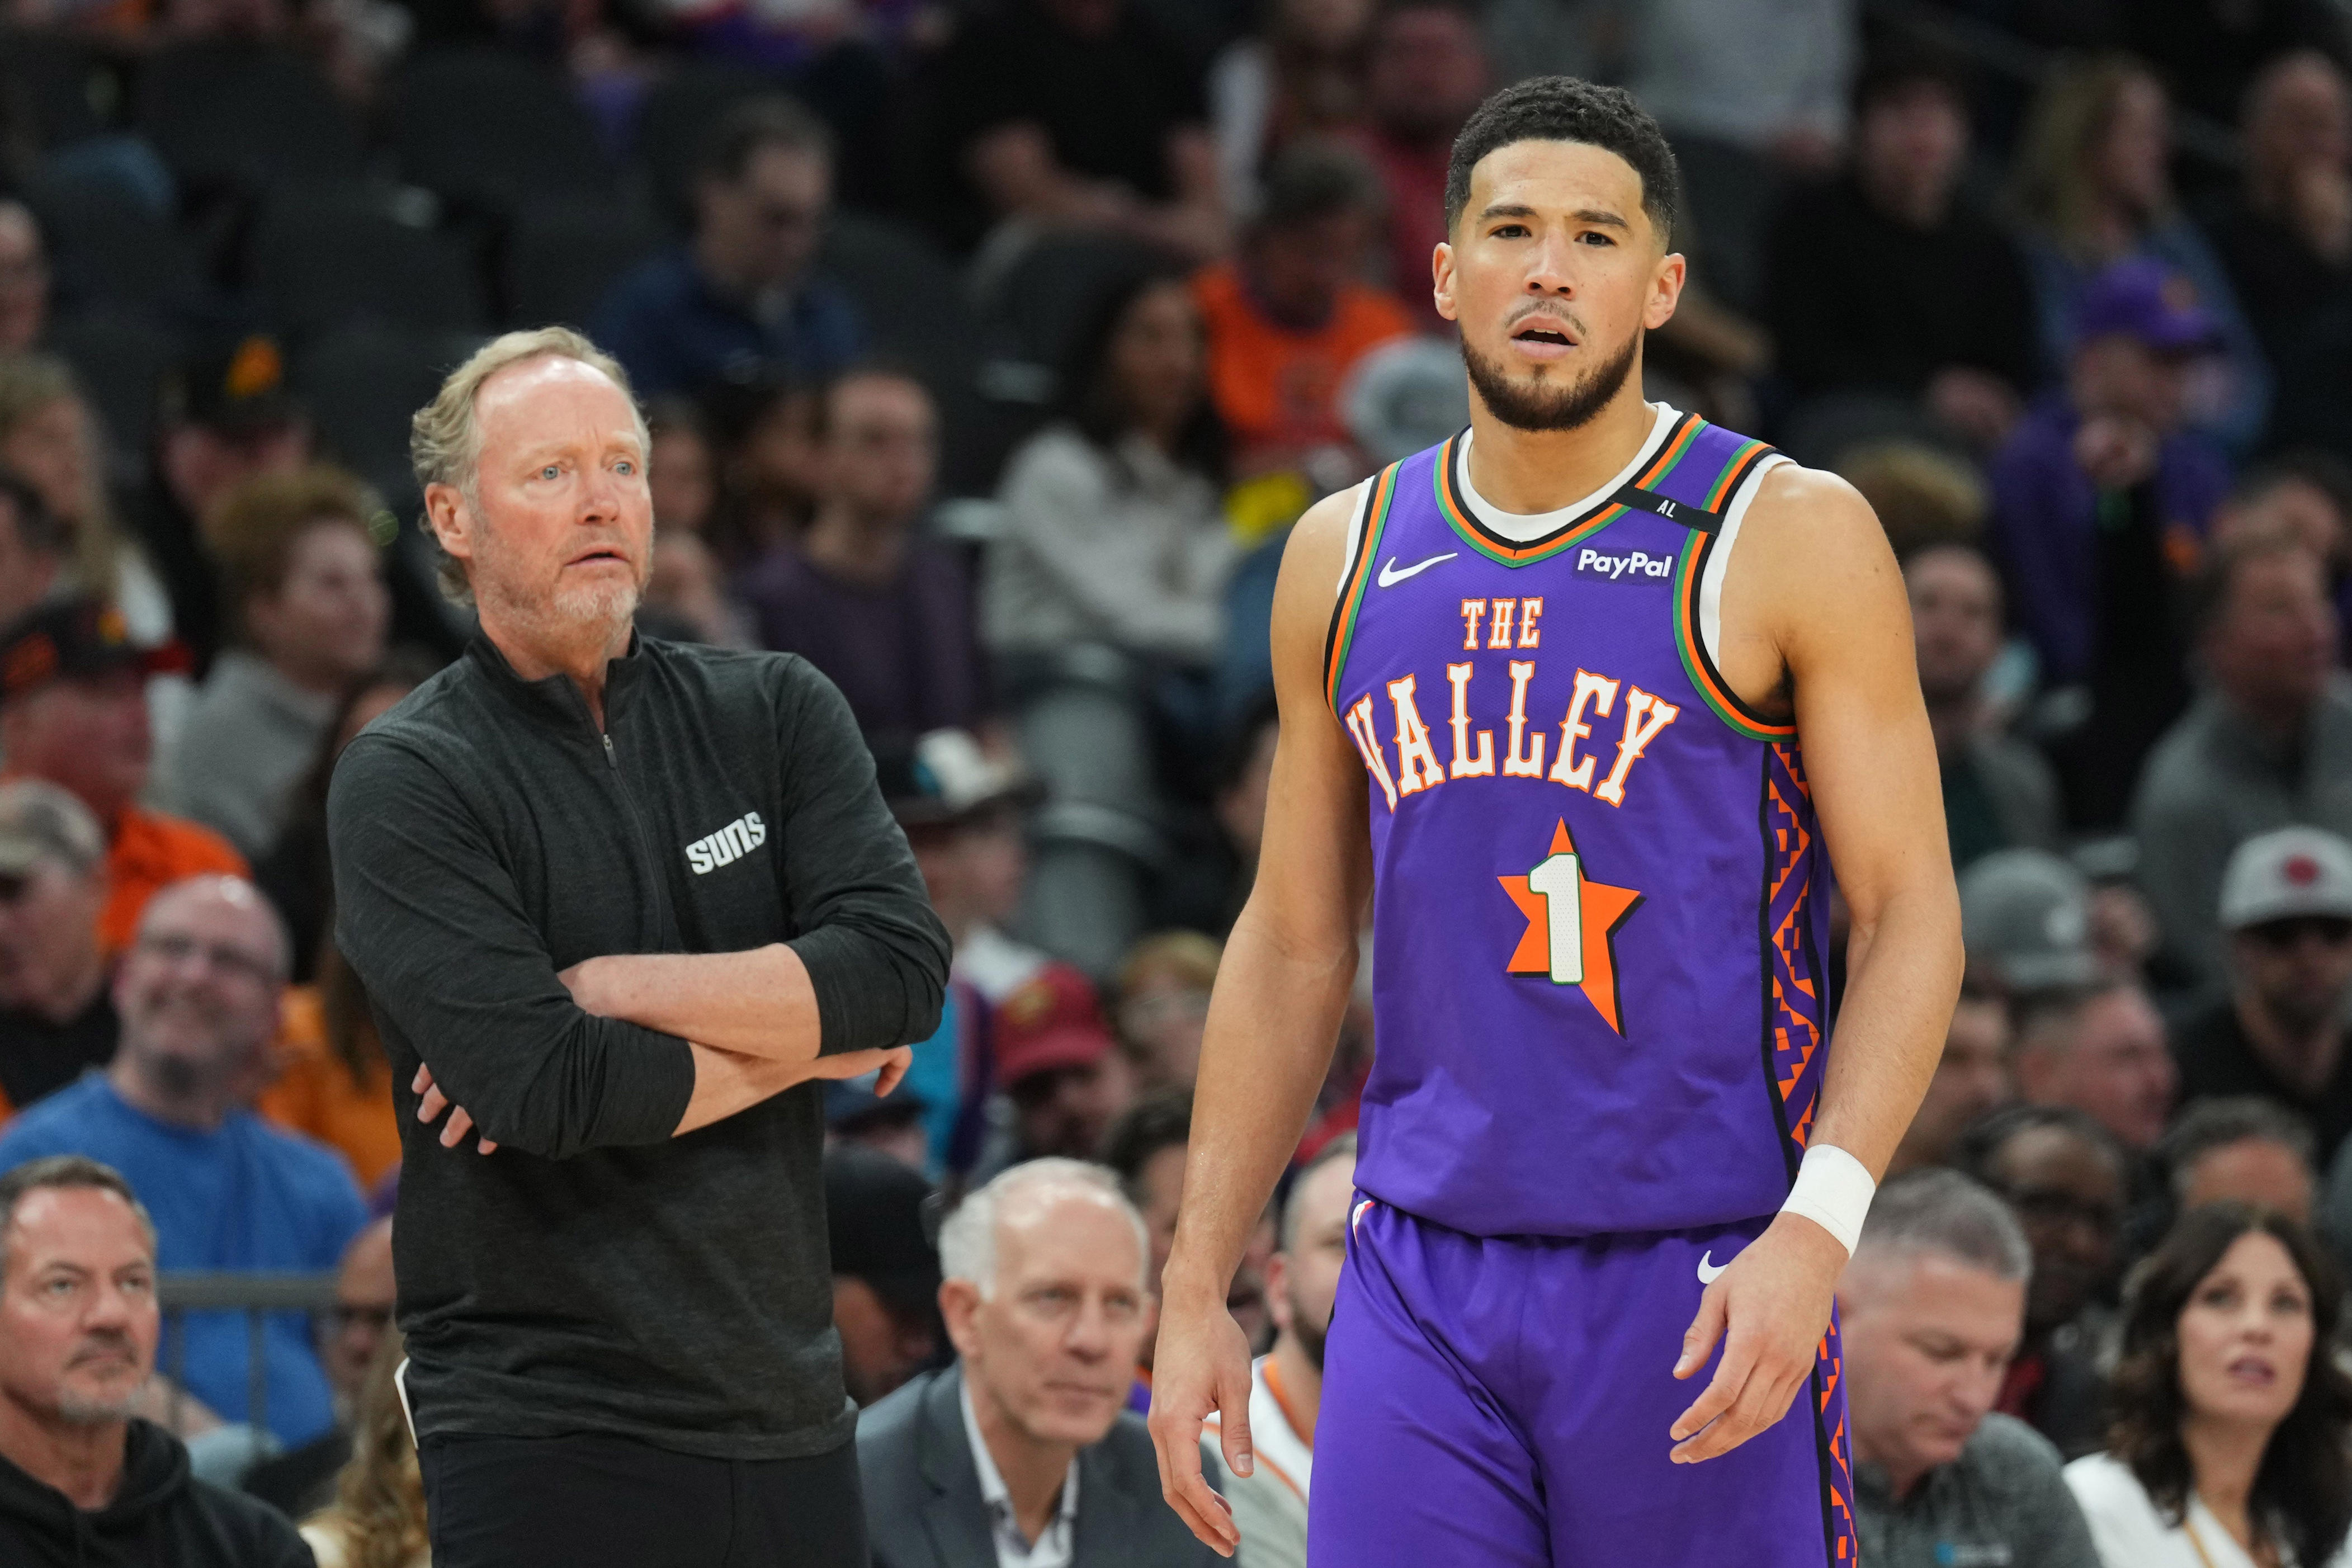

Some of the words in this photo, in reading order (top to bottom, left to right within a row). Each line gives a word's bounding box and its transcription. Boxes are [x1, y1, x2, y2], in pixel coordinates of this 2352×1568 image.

[1656, 499, 1676, 518] AL
[1578, 549, 1673, 579] PayPal
[1461, 597, 1543, 650] THE
[1345, 660, 1680, 813] VALLEY
[1528, 852, 1584, 985] 1
